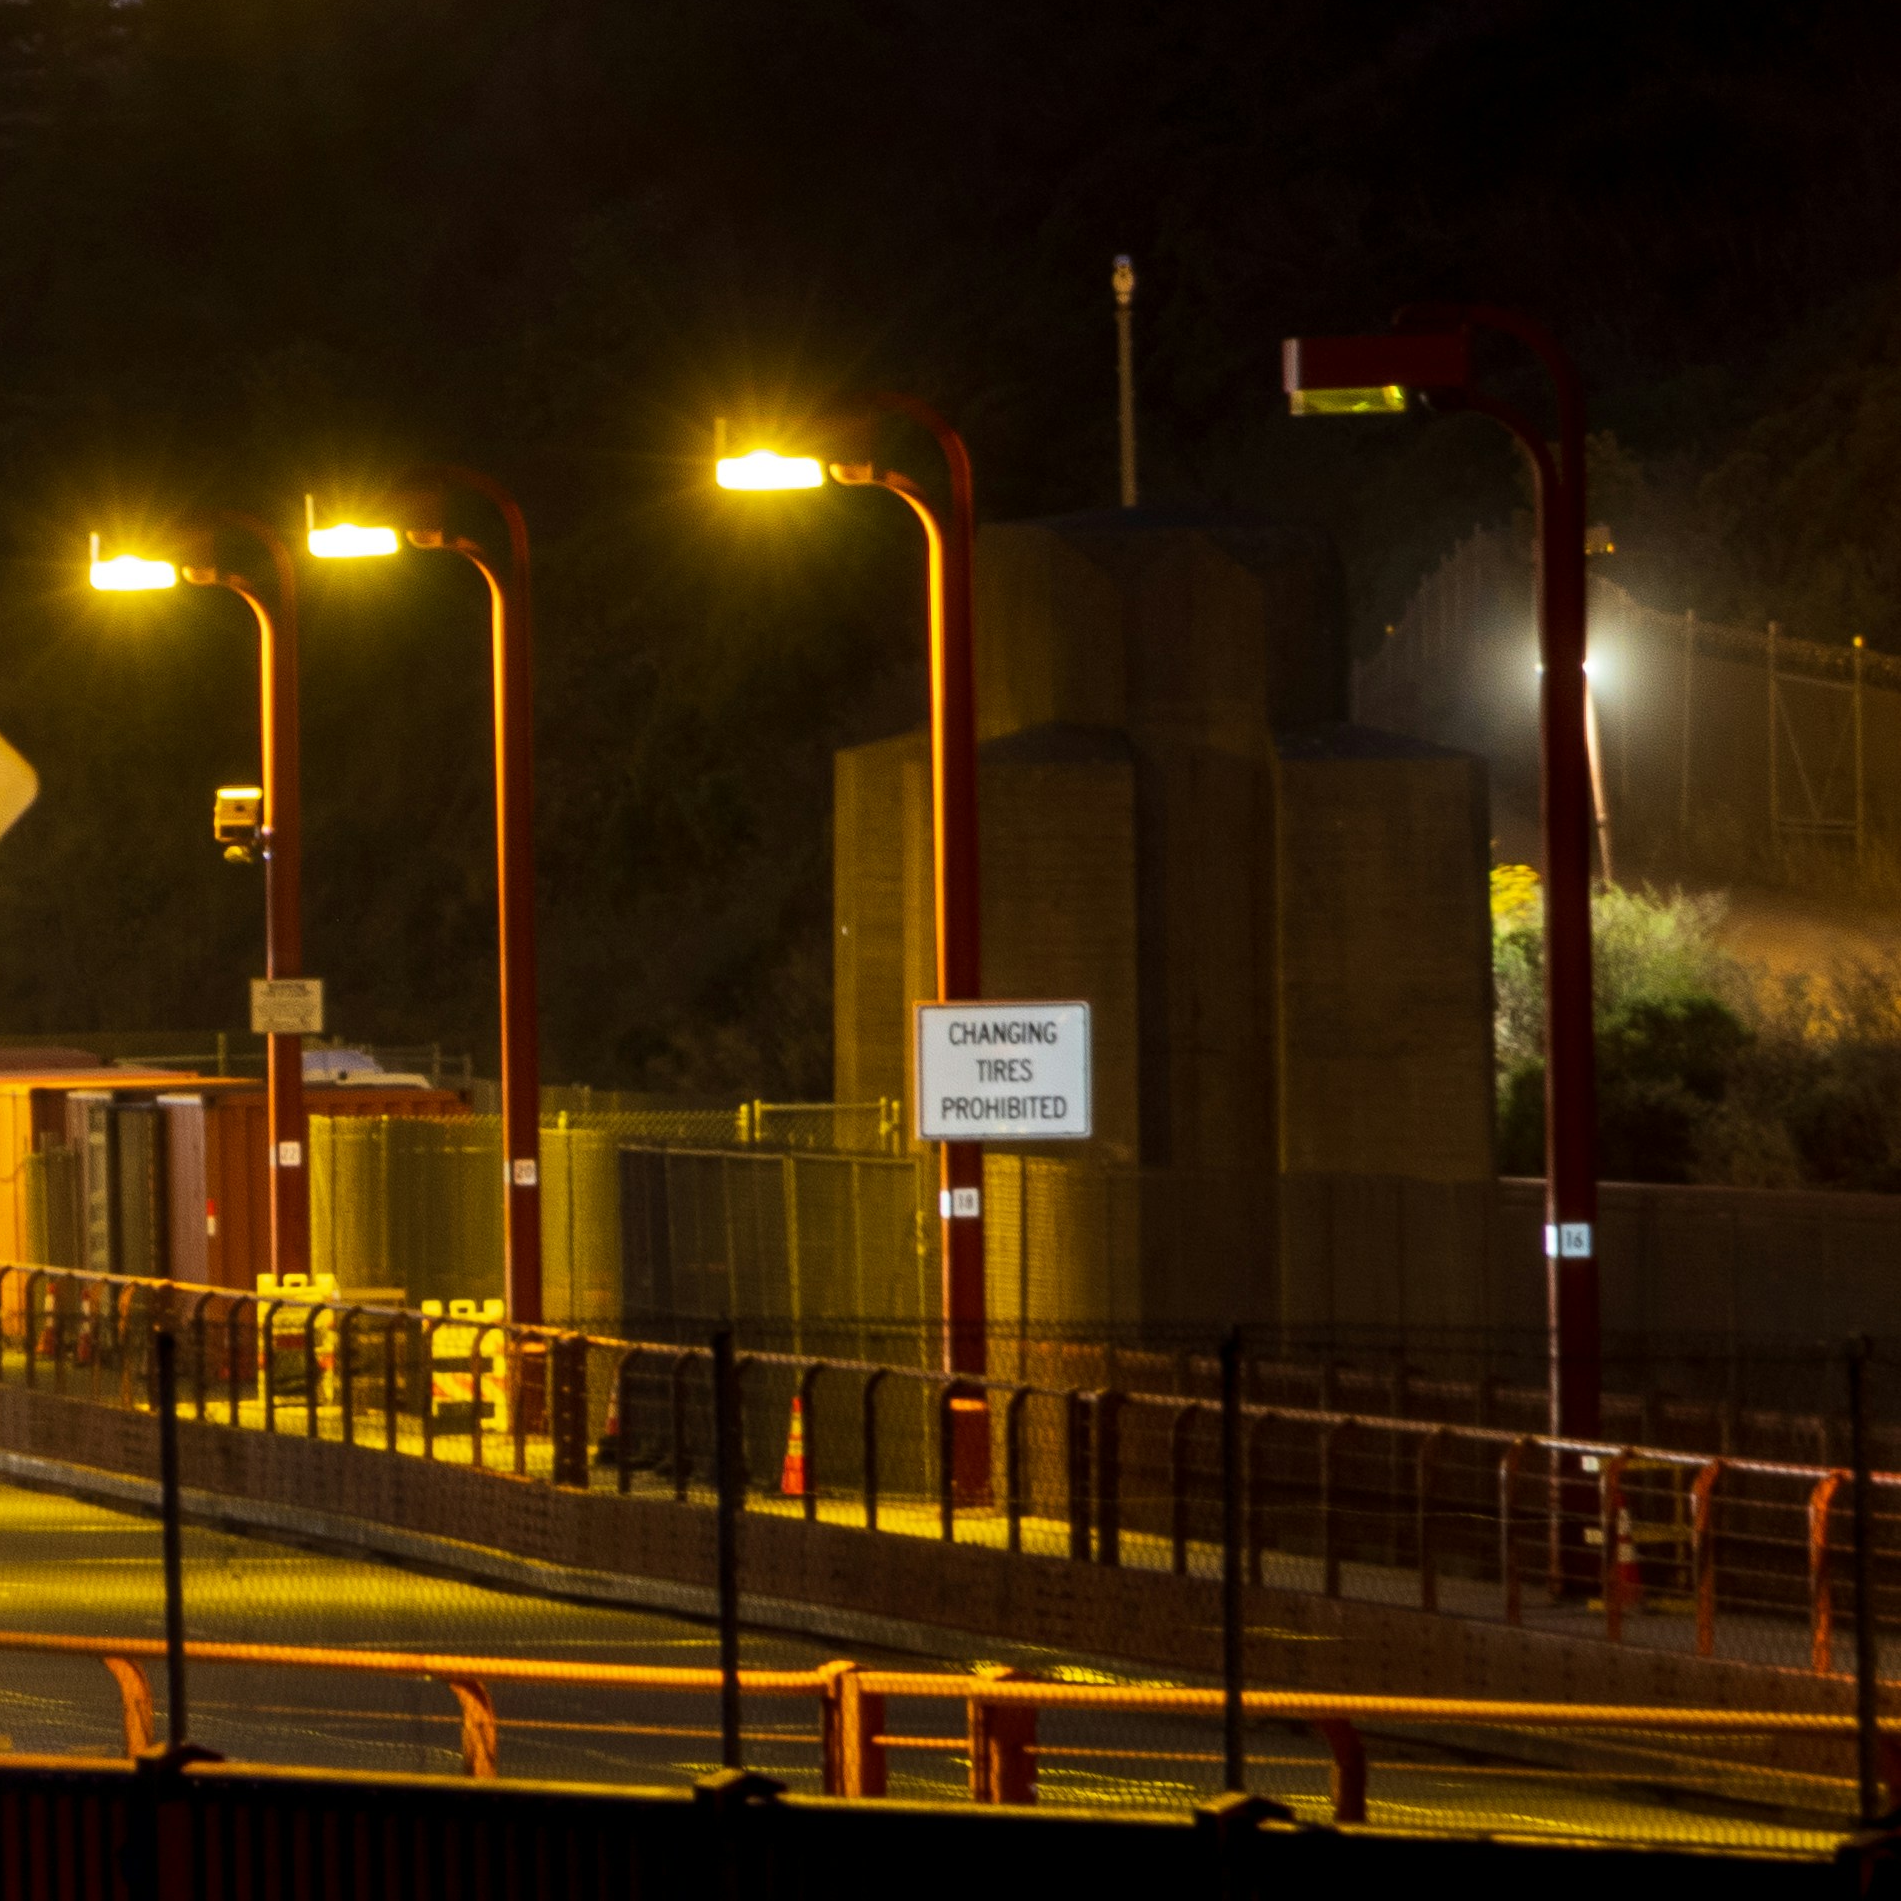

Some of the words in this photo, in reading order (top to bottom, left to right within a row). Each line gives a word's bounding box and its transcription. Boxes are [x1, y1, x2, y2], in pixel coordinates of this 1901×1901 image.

[948, 1020, 1059, 1046] CHANGING
[976, 1059, 1034, 1083] TIRES
[941, 1095, 1068, 1120] PROHIBITED
[1565, 1230, 1584, 1249] 16
